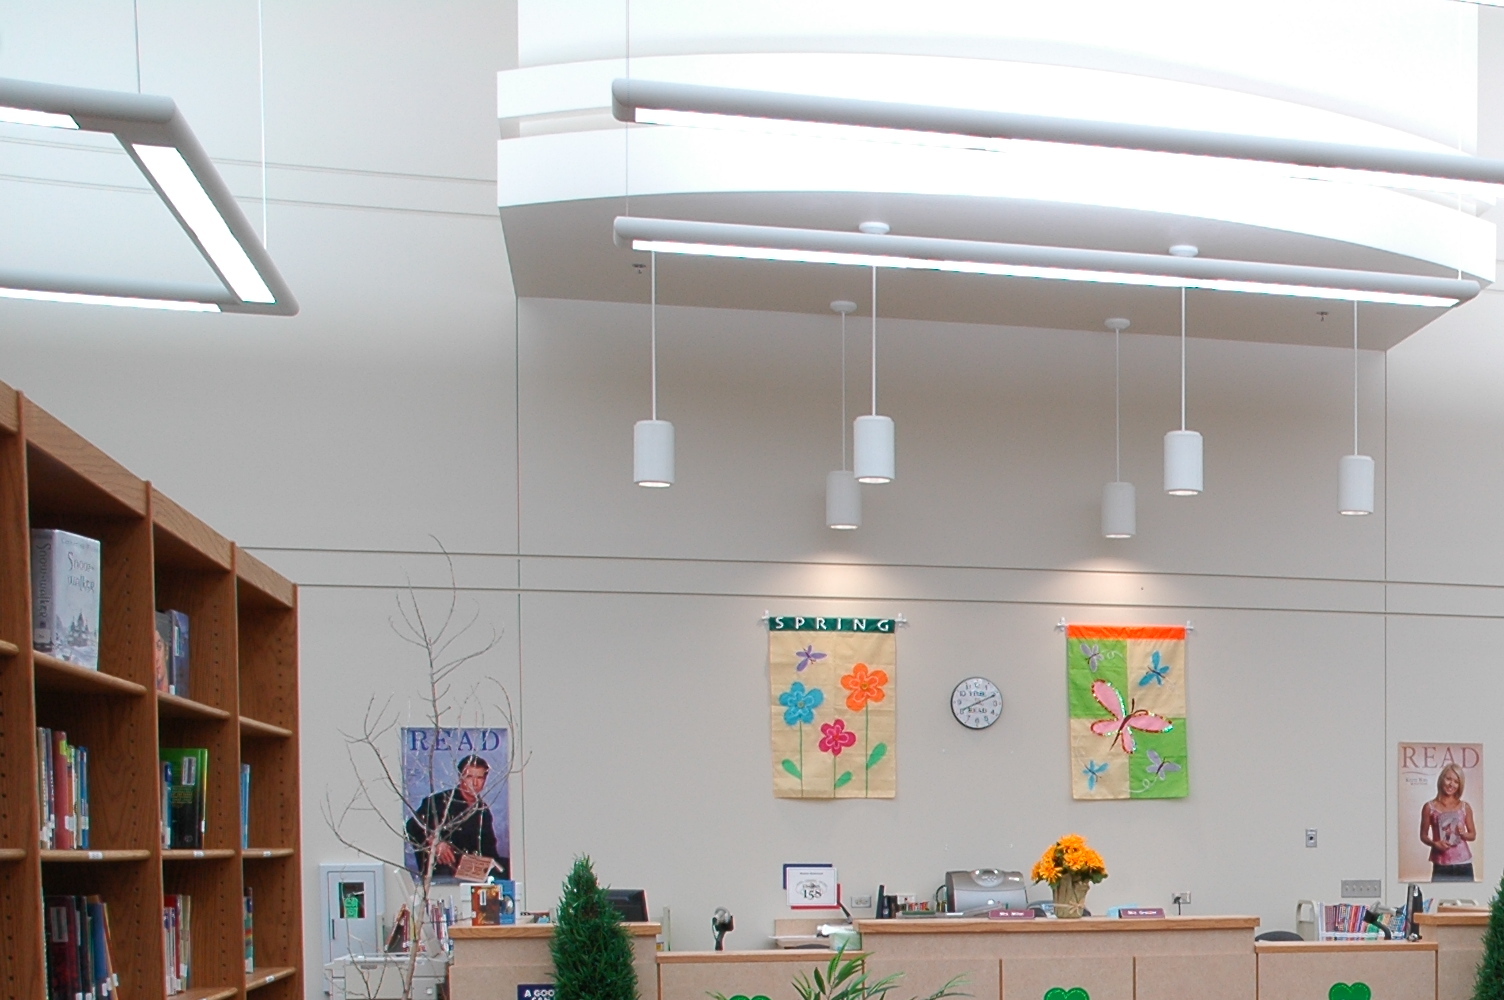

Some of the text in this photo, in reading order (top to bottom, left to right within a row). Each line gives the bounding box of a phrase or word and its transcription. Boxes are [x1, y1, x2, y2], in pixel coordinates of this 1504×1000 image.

[776, 616, 889, 631] SPRING
[410, 730, 500, 751] READ
[1401, 746, 1480, 769] READ
[803, 889, 822, 900] 158
[524, 989, 555, 998] A GOO
